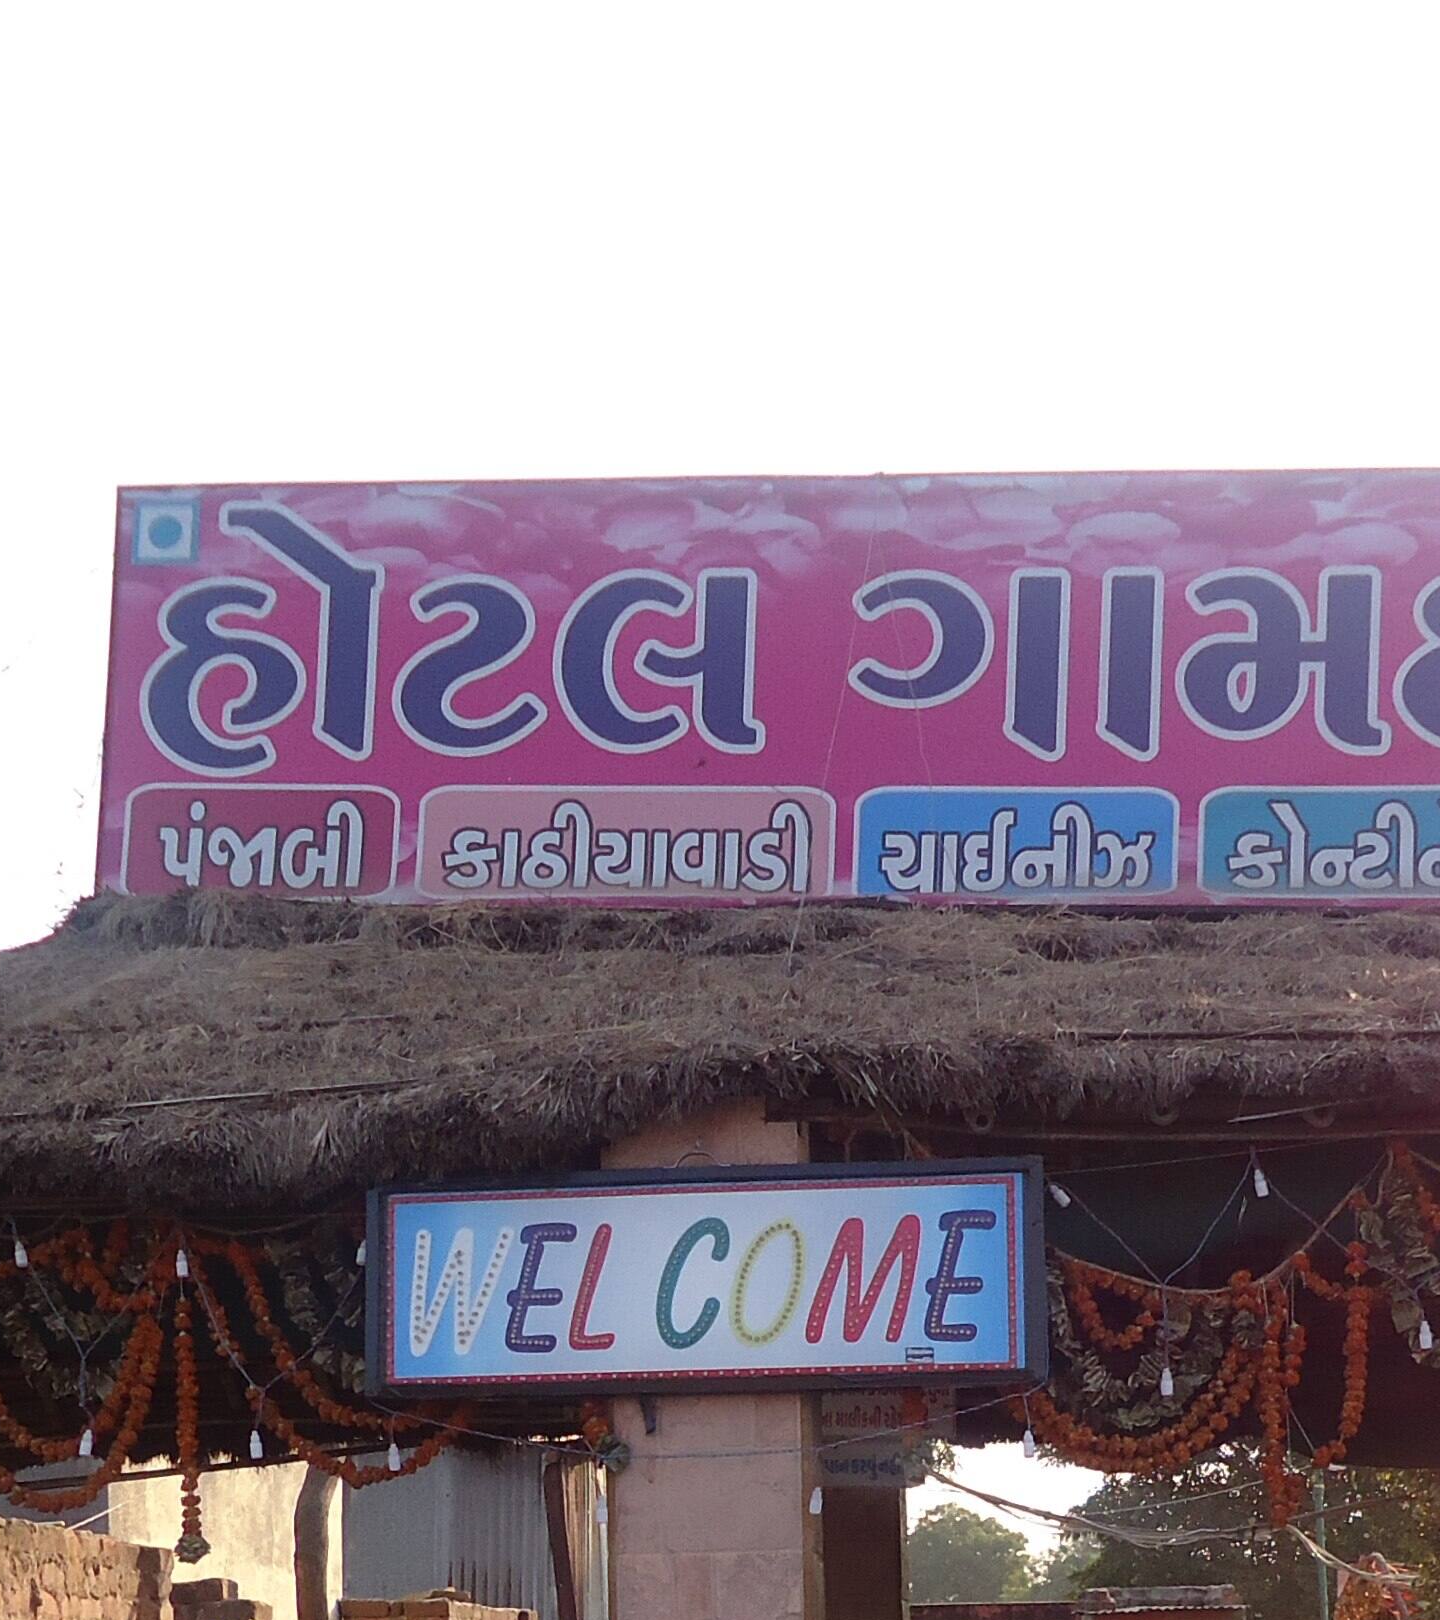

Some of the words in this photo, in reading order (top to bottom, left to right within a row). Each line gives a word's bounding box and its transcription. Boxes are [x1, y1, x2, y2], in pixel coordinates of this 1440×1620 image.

[140, 501, 766, 776] હોટલ
[157, 798, 366, 890] પંજાબી
[442, 799, 813, 893] કાઠીયાવાડી
[877, 802, 1157, 894] ચાઈનીઝ
